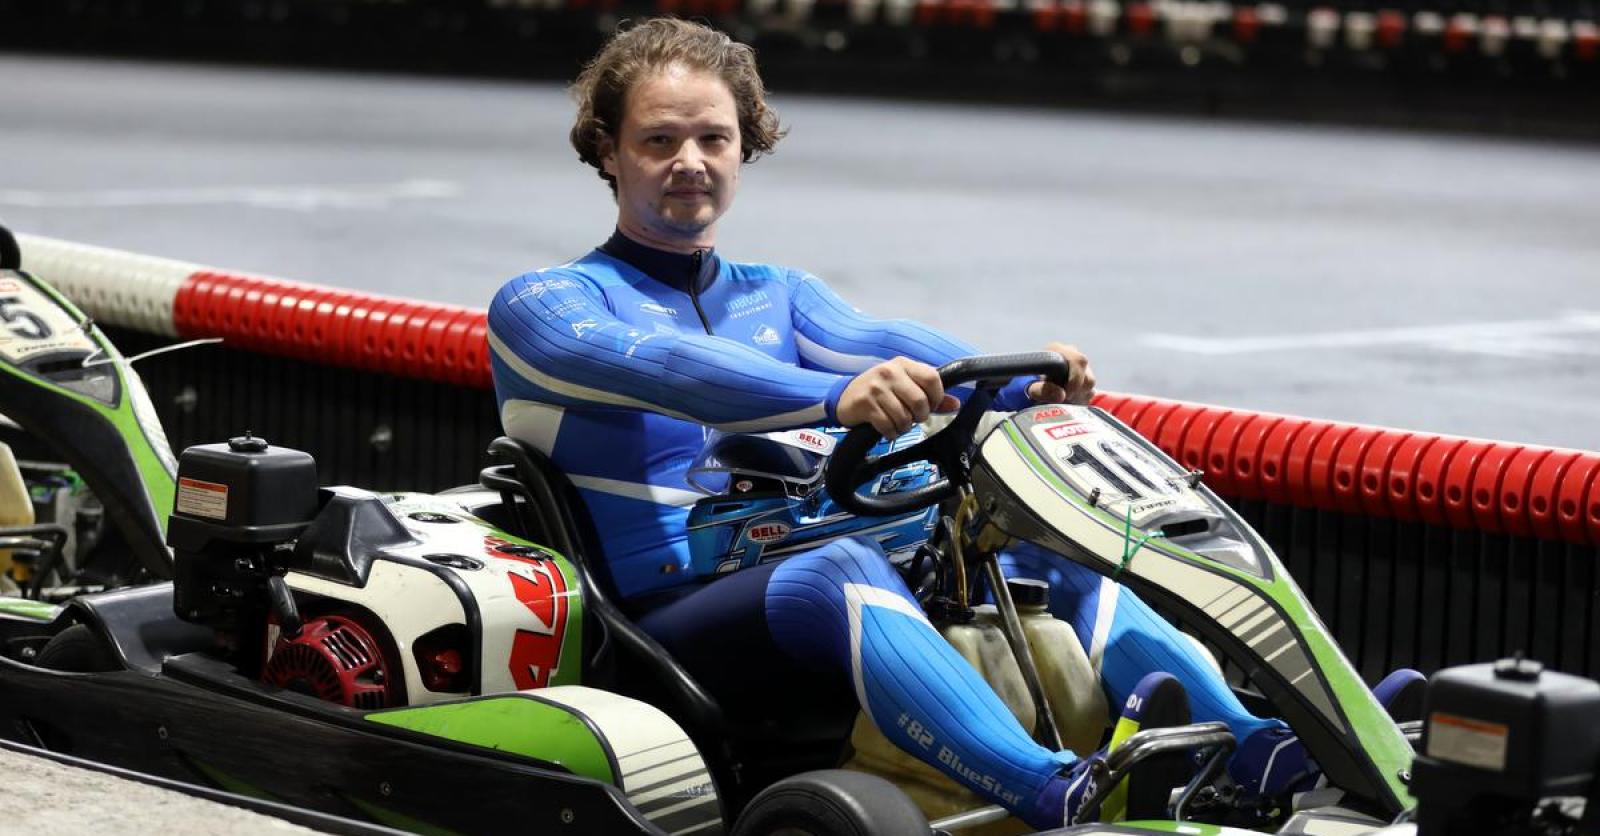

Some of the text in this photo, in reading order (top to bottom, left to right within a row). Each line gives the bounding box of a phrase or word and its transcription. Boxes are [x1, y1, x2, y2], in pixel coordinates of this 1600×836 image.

[798, 432, 824, 447] BELL
[751, 525, 786, 539] BELL
[897, 713, 935, 751] #82
[936, 743, 1025, 807] BlueStar
